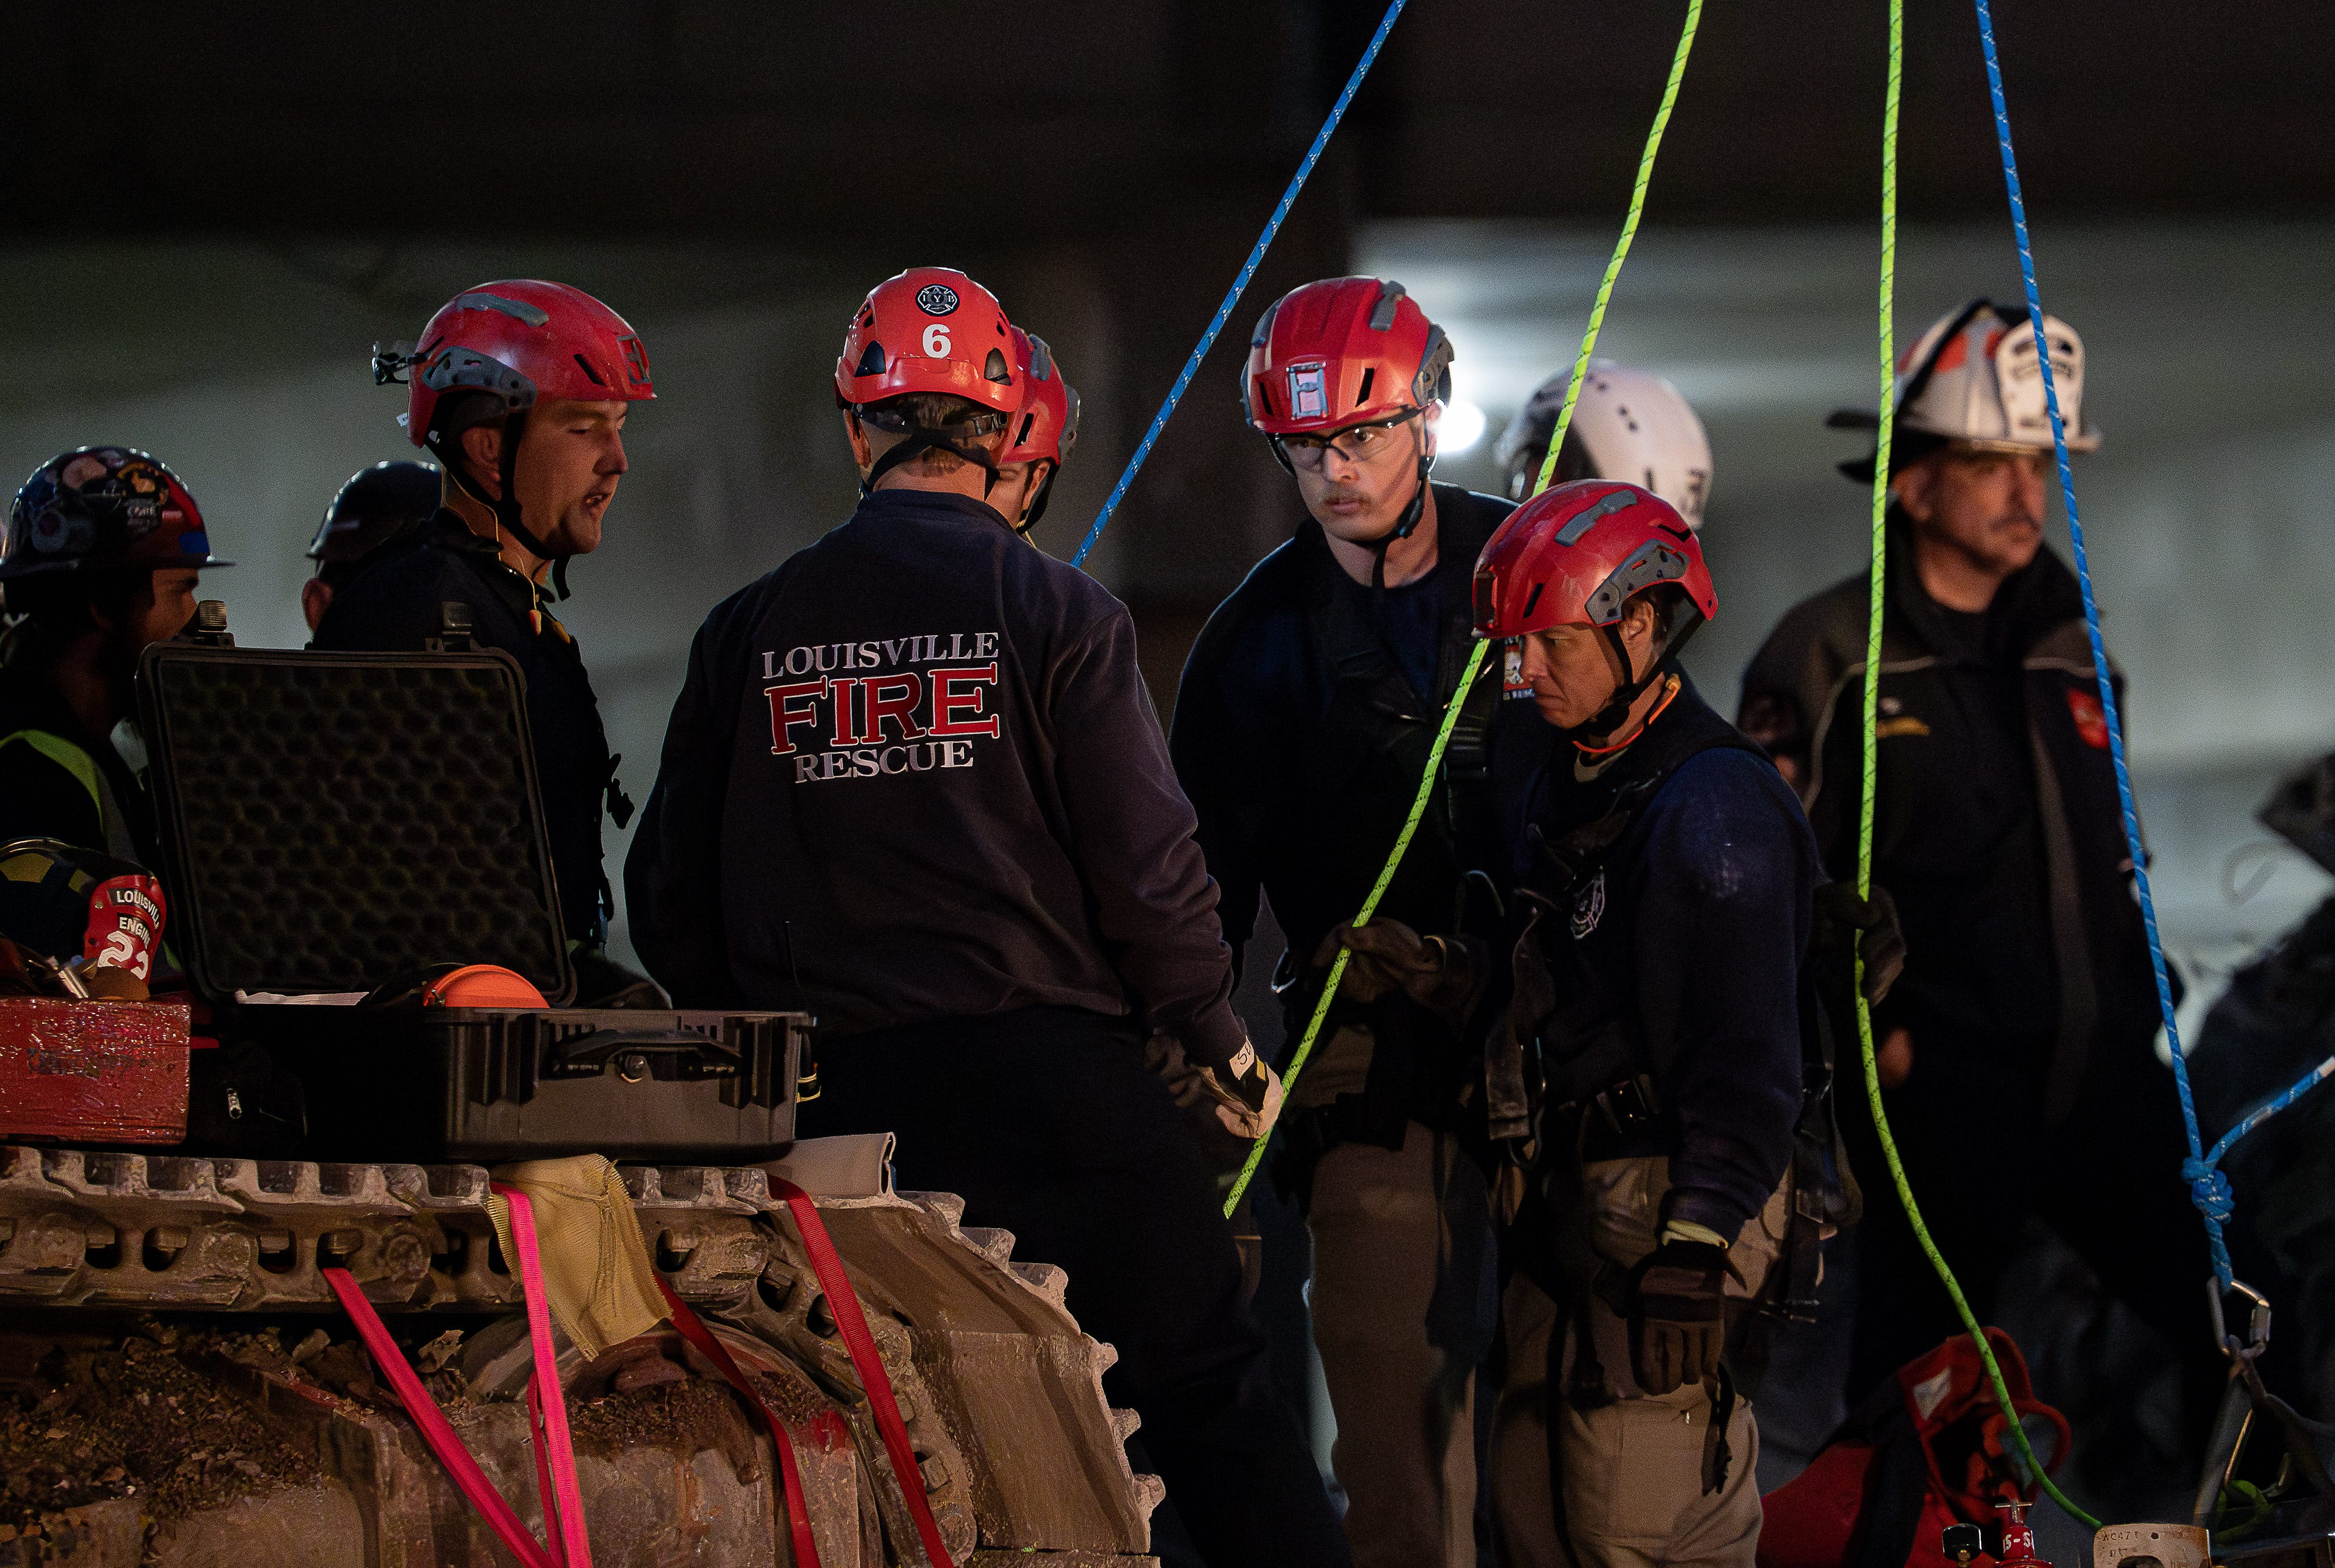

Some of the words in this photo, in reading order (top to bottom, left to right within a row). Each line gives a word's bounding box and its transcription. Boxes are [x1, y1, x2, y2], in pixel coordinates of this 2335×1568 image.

[922, 323, 952, 359] 6
[762, 632, 999, 679] LOUISVILLE
[764, 662, 1000, 755] FIRE
[793, 740, 974, 783] RESCUE
